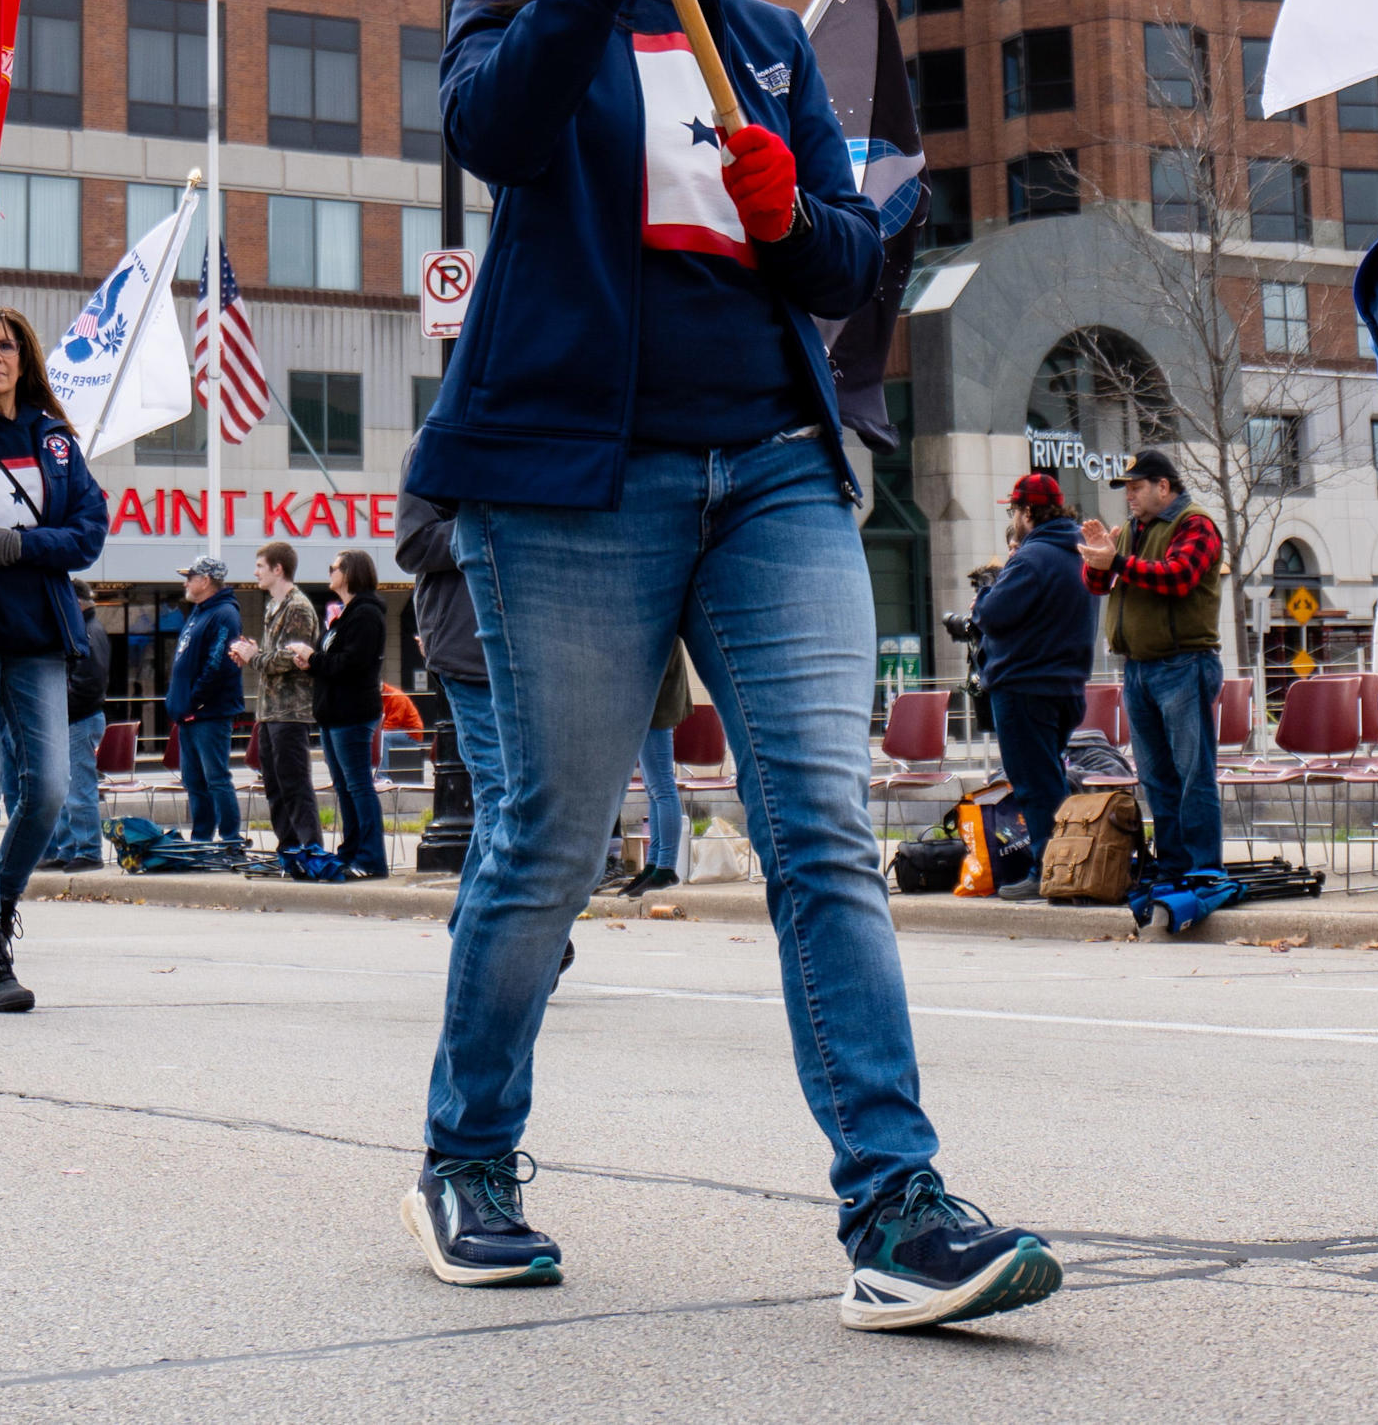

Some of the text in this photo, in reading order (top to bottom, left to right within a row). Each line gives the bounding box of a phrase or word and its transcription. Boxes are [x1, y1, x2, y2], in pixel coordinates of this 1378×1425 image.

[1033, 440, 1085, 469] RIVER
[103, 488, 398, 538] AINT KATE
